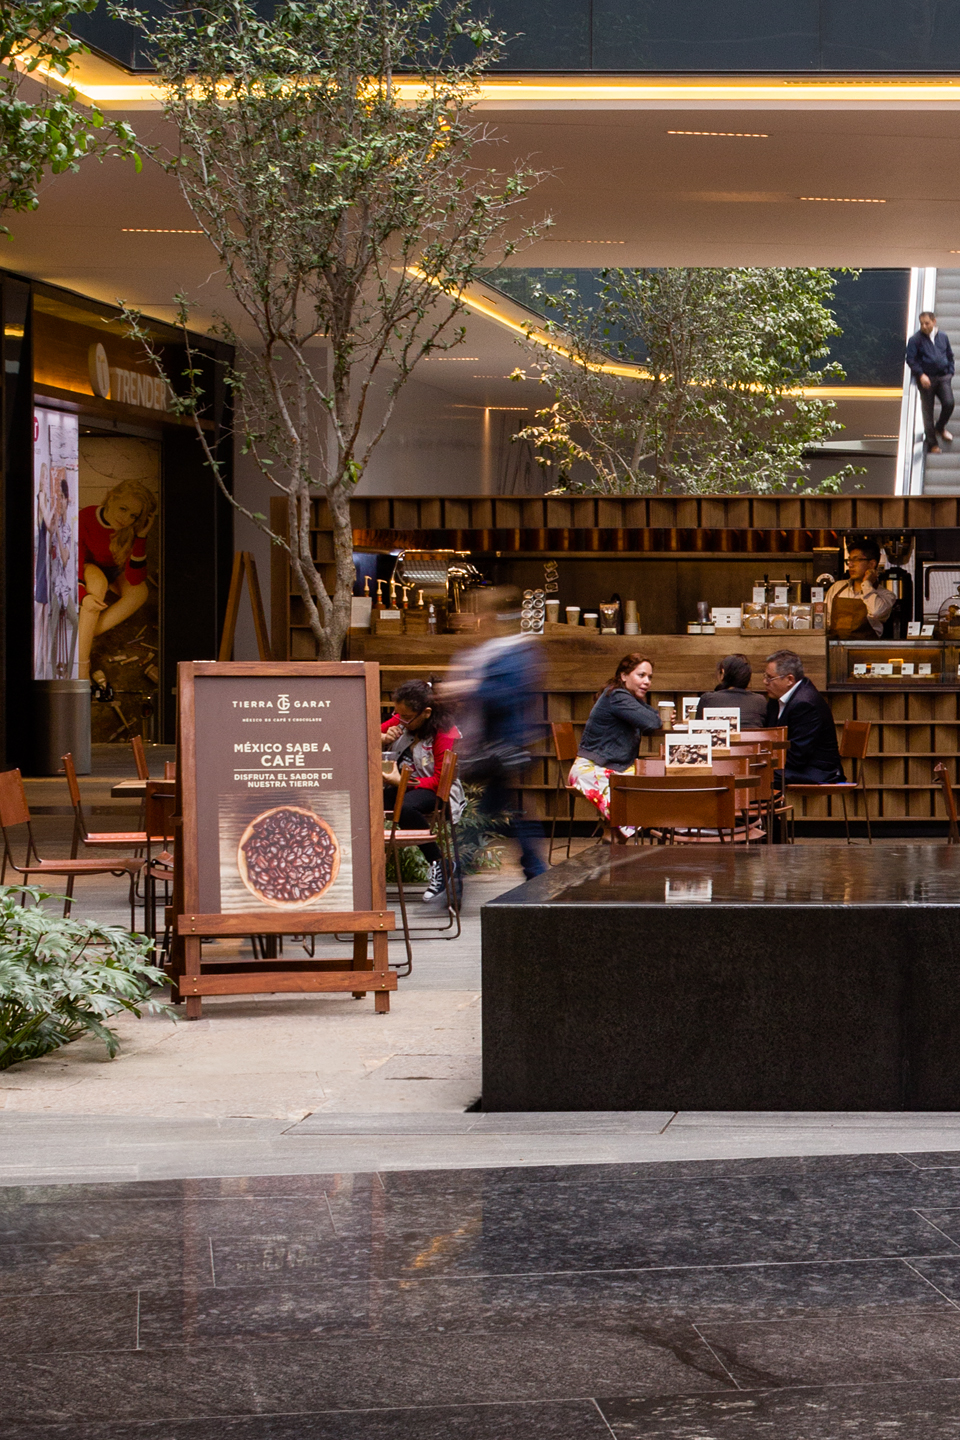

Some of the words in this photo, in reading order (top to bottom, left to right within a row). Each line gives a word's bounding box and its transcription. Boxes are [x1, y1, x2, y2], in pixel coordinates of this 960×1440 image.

[116, 367, 167, 411] TRENDER
[232, 700, 274, 708] TIERRA
[293, 700, 331, 708] GARAT
[234, 741, 282, 753] MÉXICO
[286, 743, 318, 752] SABE
[322, 743, 331, 752] A
[261, 752, 305, 767] CAFÉ
[234, 773, 275, 781] DISFRUTA
[321, 772, 333, 780] DE
